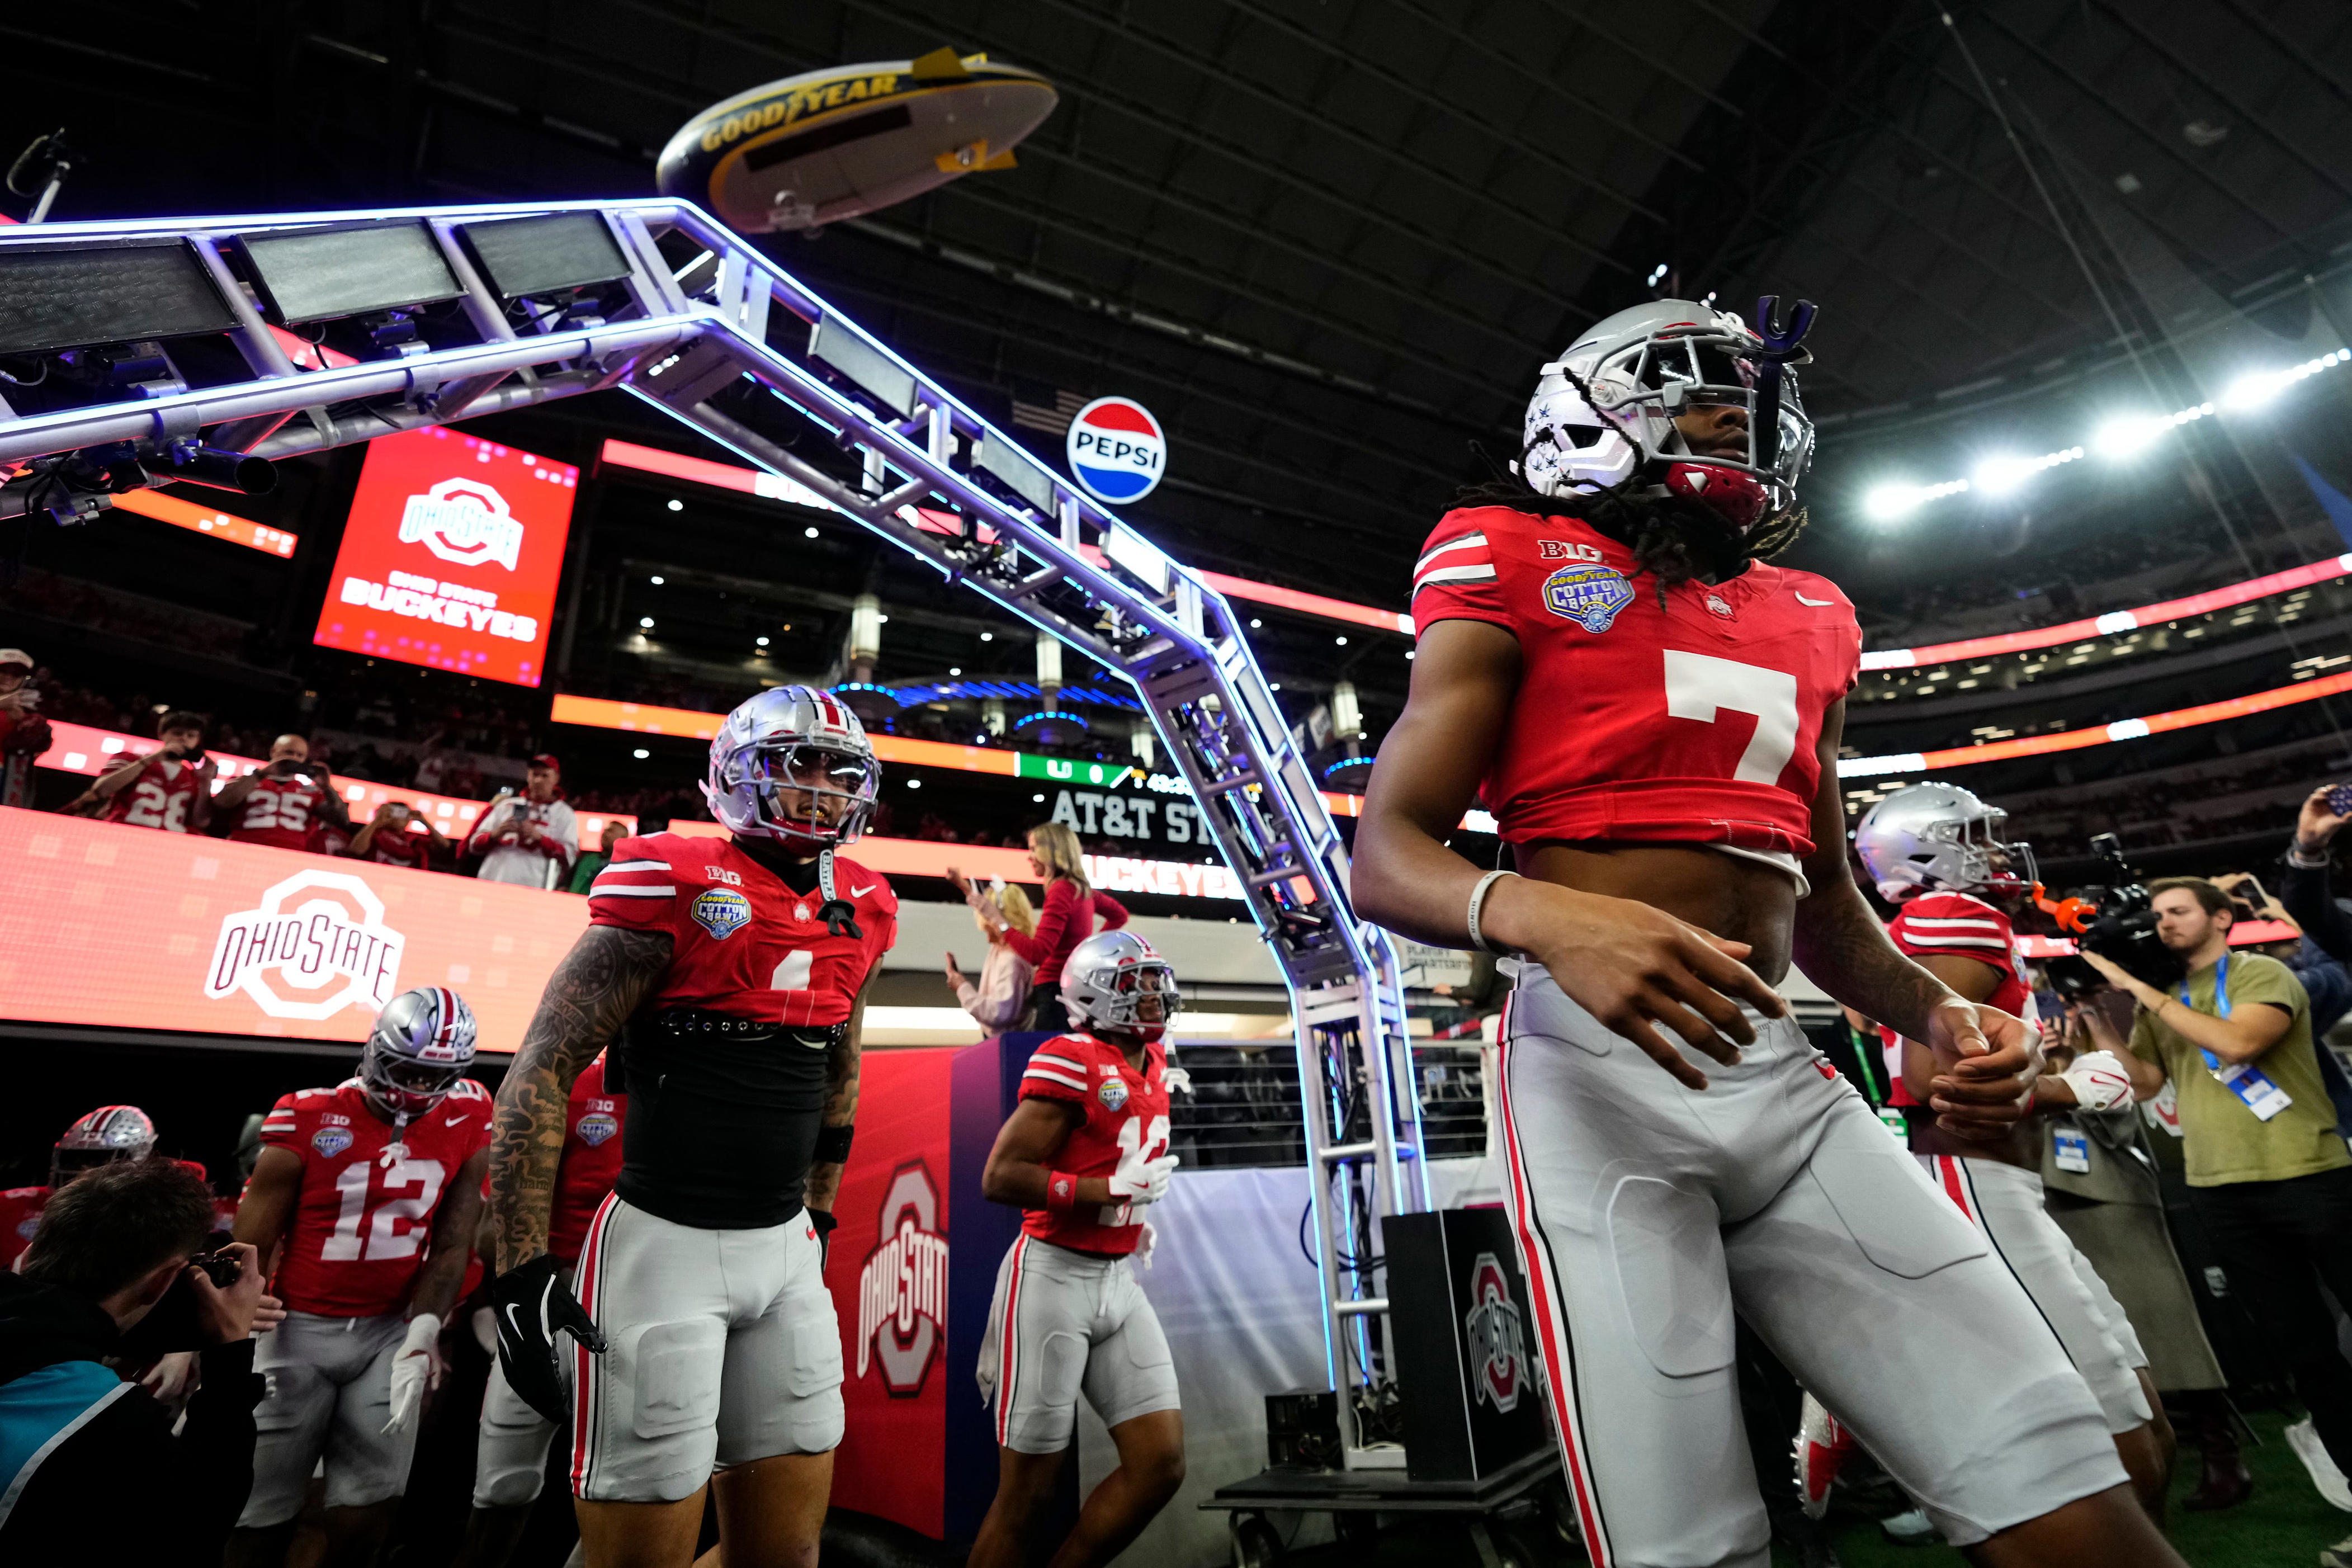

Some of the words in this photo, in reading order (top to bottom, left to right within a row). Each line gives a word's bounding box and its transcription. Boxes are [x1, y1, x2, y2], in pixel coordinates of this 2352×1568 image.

[1076, 431, 1158, 468] PEPSI
[1550, 571, 1618, 586] GOODYEAR
[1550, 579, 1628, 607] COTTON
[341, 577, 537, 642] BUCKEYES
[1567, 592, 1615, 610] BOWL
[1663, 649, 1798, 786] 7
[242, 789, 312, 831] 25
[1051, 789, 1156, 839] AT&T
[697, 902, 747, 920] COTTON
[771, 949, 814, 991] 1
[320, 1158, 446, 1262] 12
